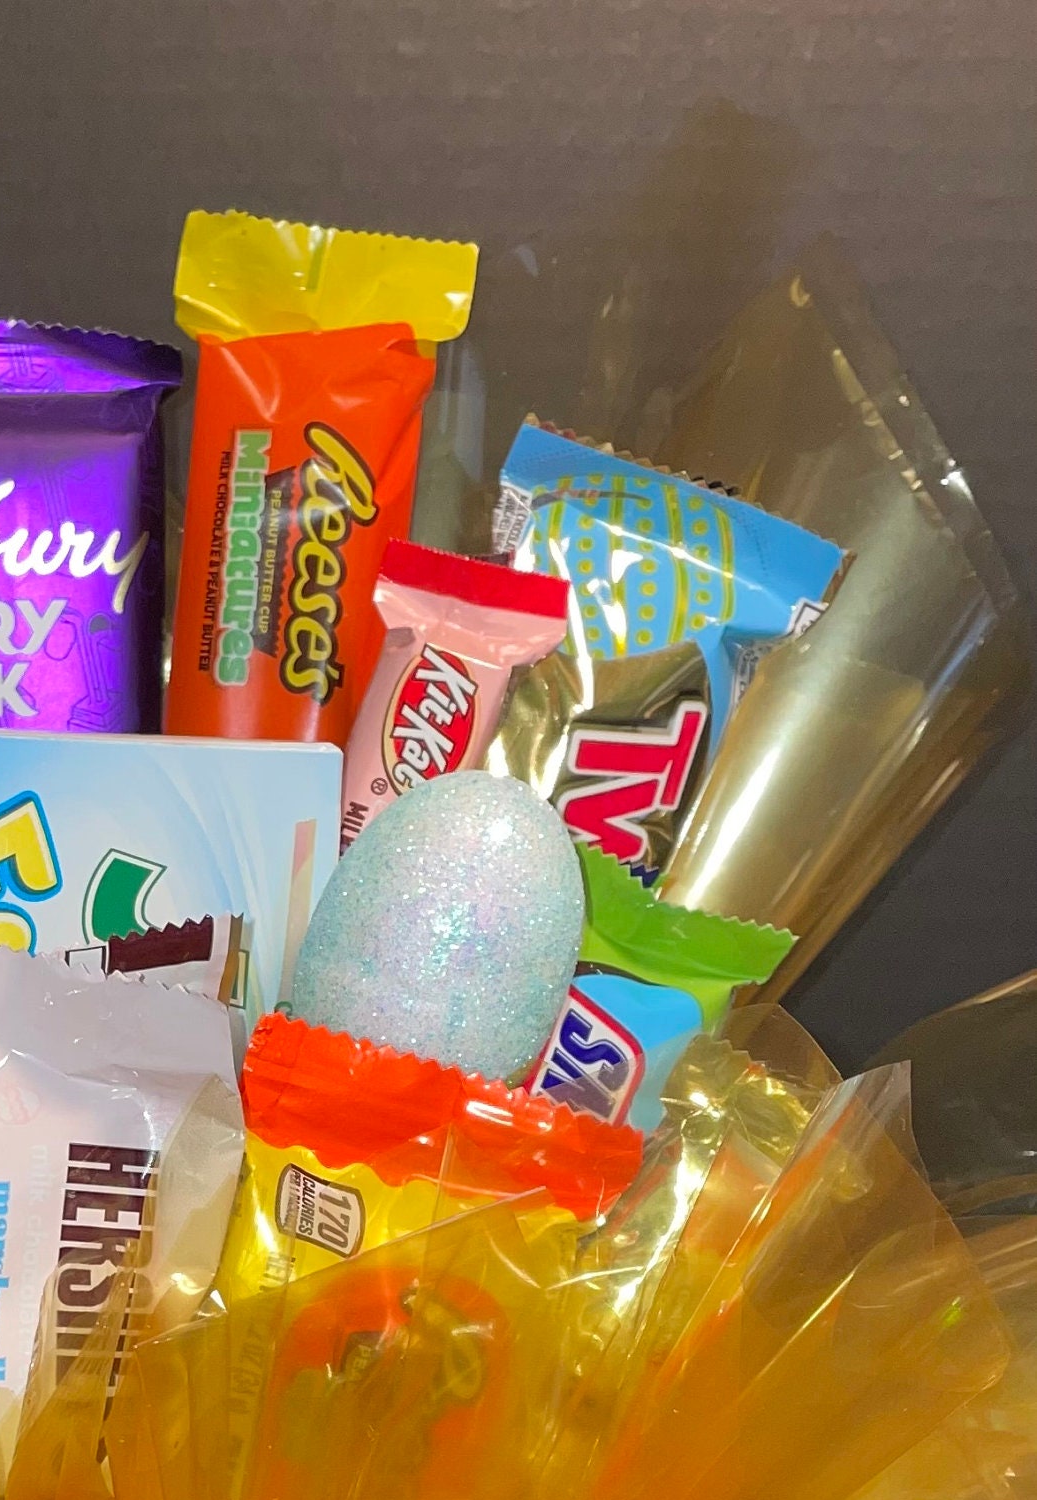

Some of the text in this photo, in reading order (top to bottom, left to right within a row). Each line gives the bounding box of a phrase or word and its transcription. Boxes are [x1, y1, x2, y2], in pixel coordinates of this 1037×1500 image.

[220, 451, 232, 478] MILK
[212, 480, 229, 557] CHOCOLATE
[215, 429, 272, 686] Miniatures
[259, 489, 282, 635] PEANUT BUTTER CUP
[281, 423, 378, 705] Reese's
[205, 568, 220, 622] PEANUT
[199, 623, 213, 672] BUTTER
[298, 1174, 316, 1237] CALORIES
[317, 1188, 352, 1251] 170
